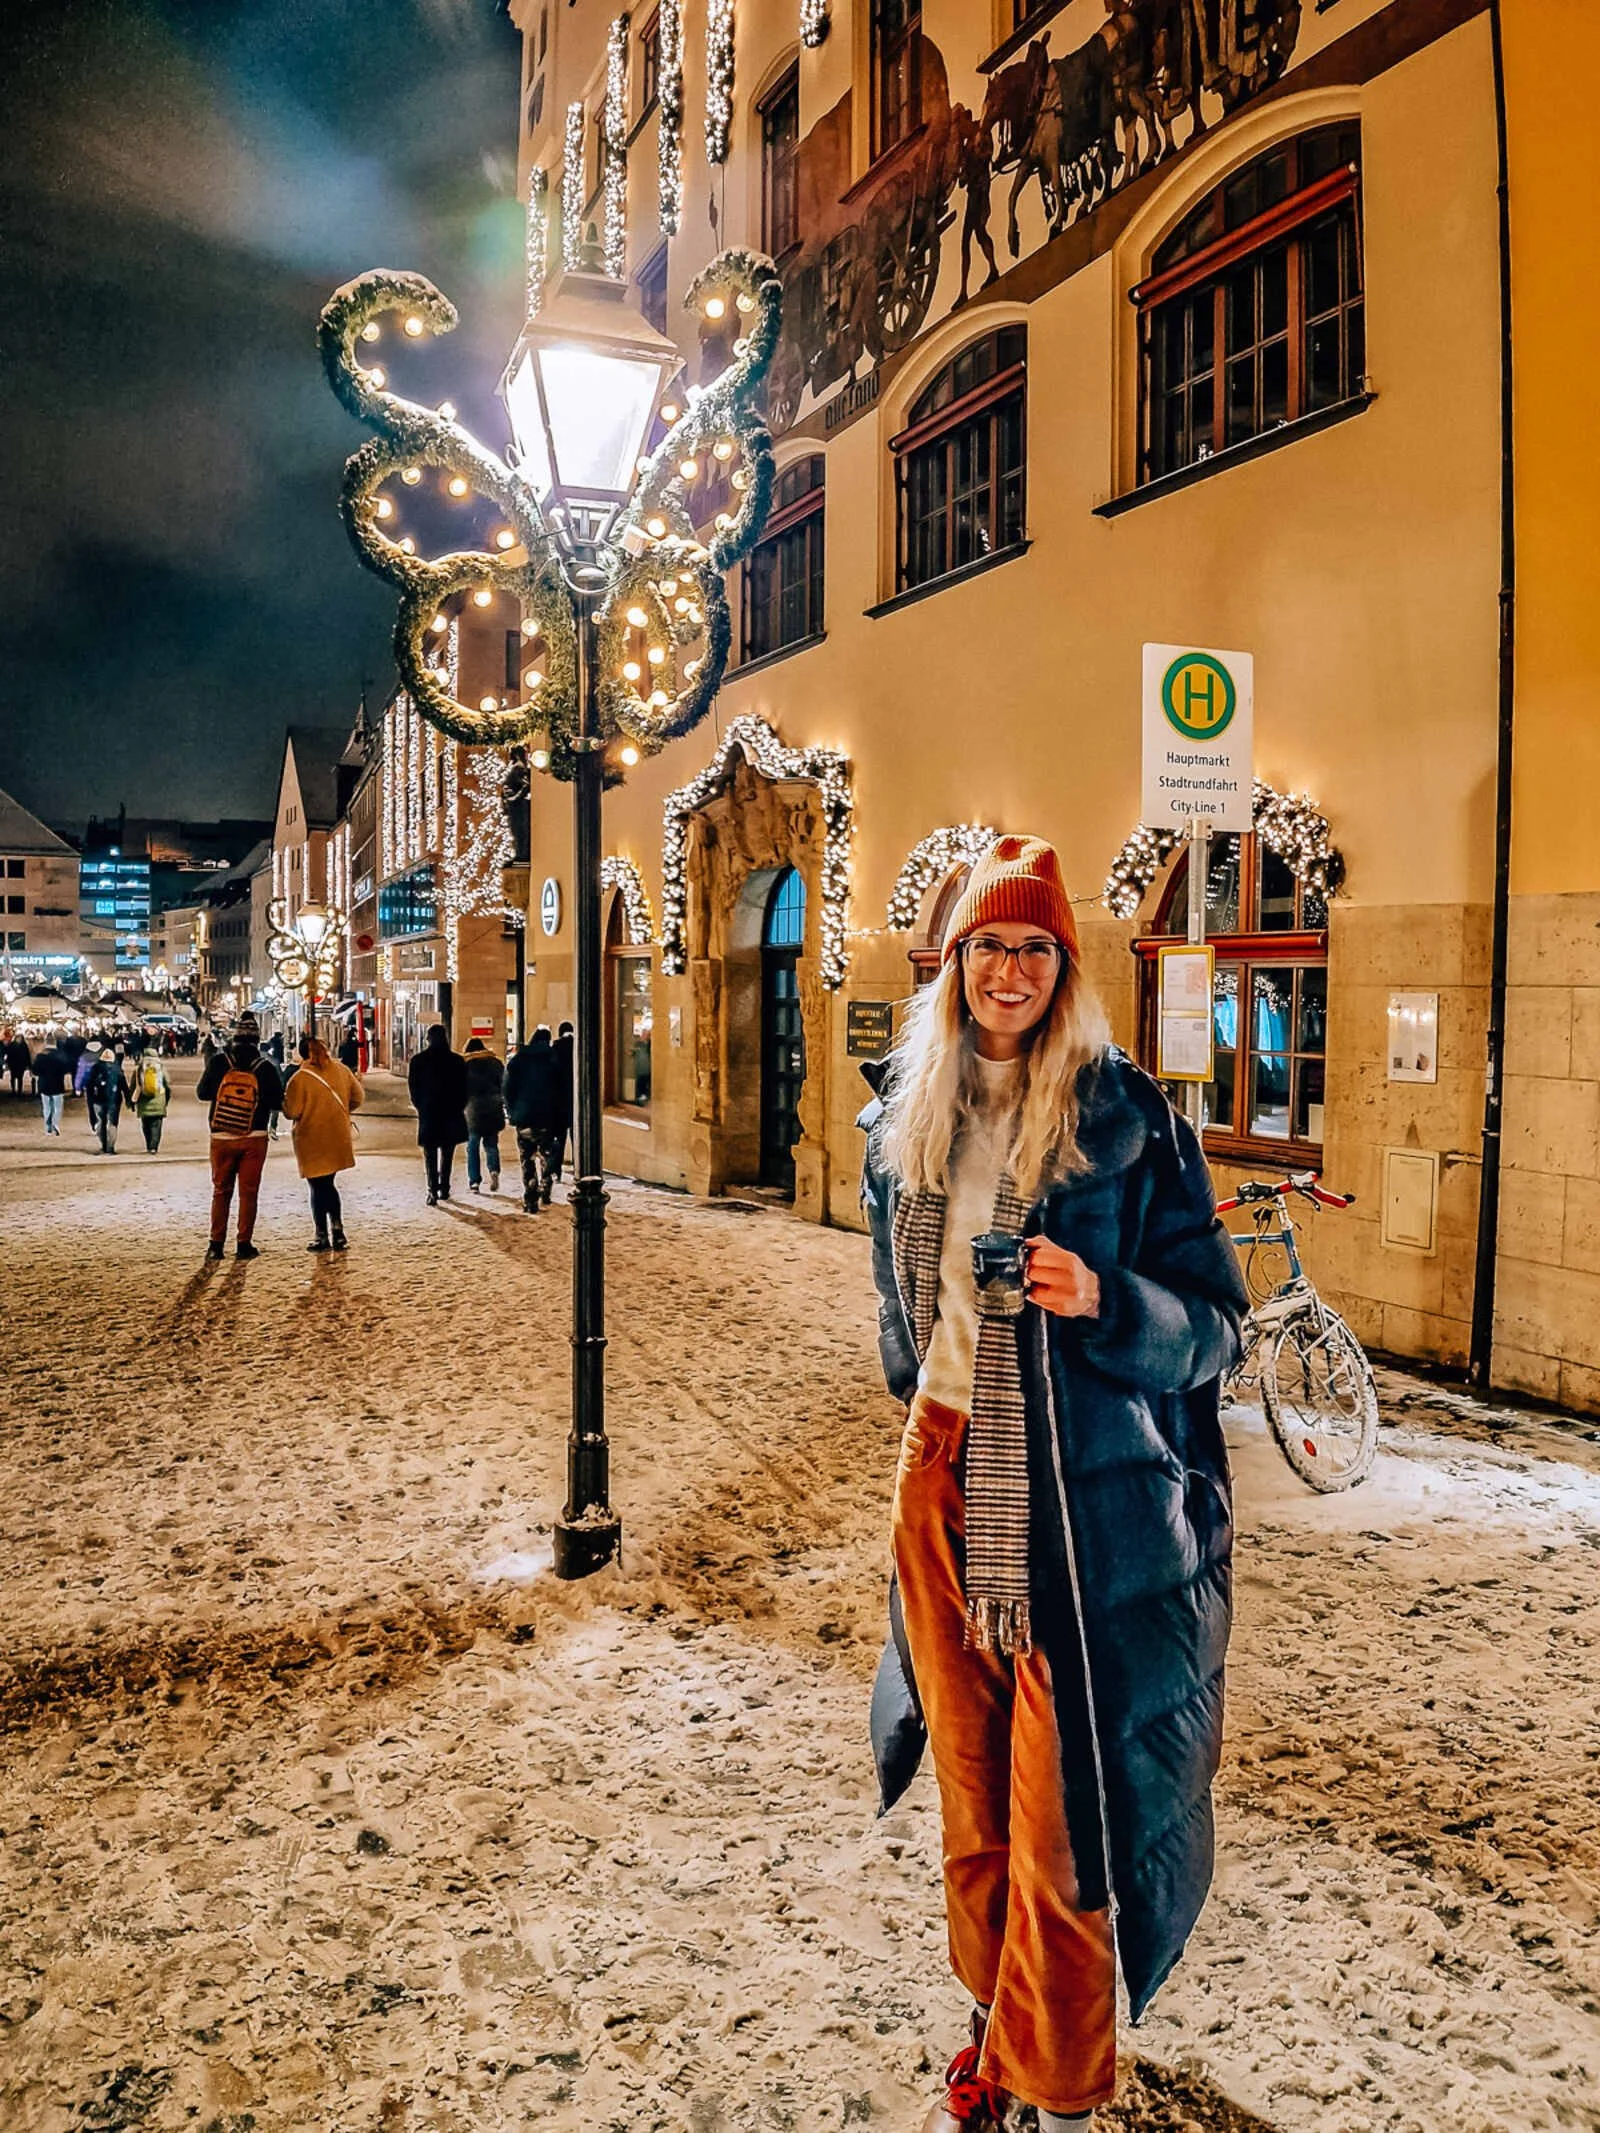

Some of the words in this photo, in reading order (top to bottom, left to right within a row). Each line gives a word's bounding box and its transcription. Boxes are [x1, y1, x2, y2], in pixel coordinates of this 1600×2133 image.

[1184, 671, 1215, 721] H
[1166, 751, 1230, 768] Hauptmarkt
[1159, 775, 1238, 792] Stadtrundfahrt
[1170, 799, 1217, 815] City-Line
[1220, 802, 1225, 814] 1
